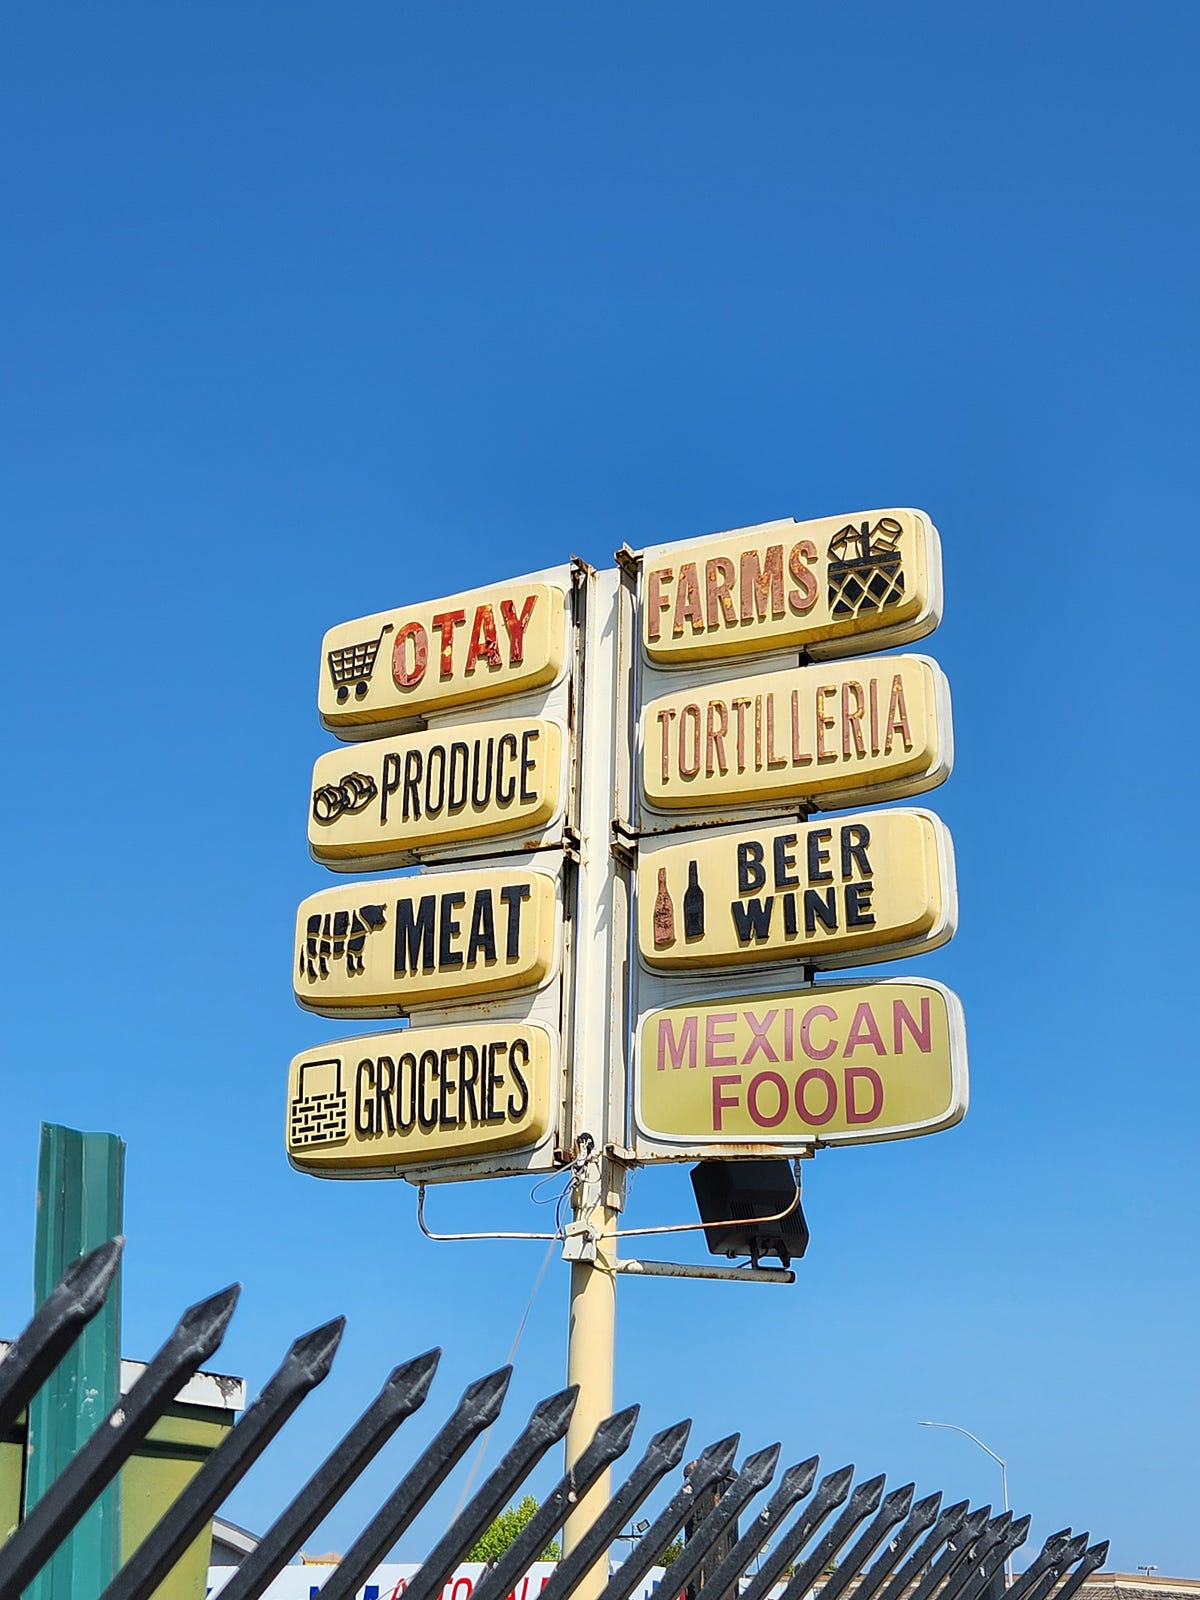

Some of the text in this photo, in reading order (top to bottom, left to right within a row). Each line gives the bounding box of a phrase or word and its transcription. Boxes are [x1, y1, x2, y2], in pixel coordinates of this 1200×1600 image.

[648, 539, 818, 640] FARMS
[393, 595, 538, 687] OTAY
[656, 674, 912, 783] TORTILLERIA
[381, 729, 539, 822] PRODUCE
[738, 822, 873, 893] BEER
[394, 884, 532, 973] MEAT
[731, 881, 876, 943] WINE
[657, 997, 932, 1071] MEXICAN
[355, 1038, 530, 1135] GROCERIES
[712, 1066, 883, 1131] FOOD
